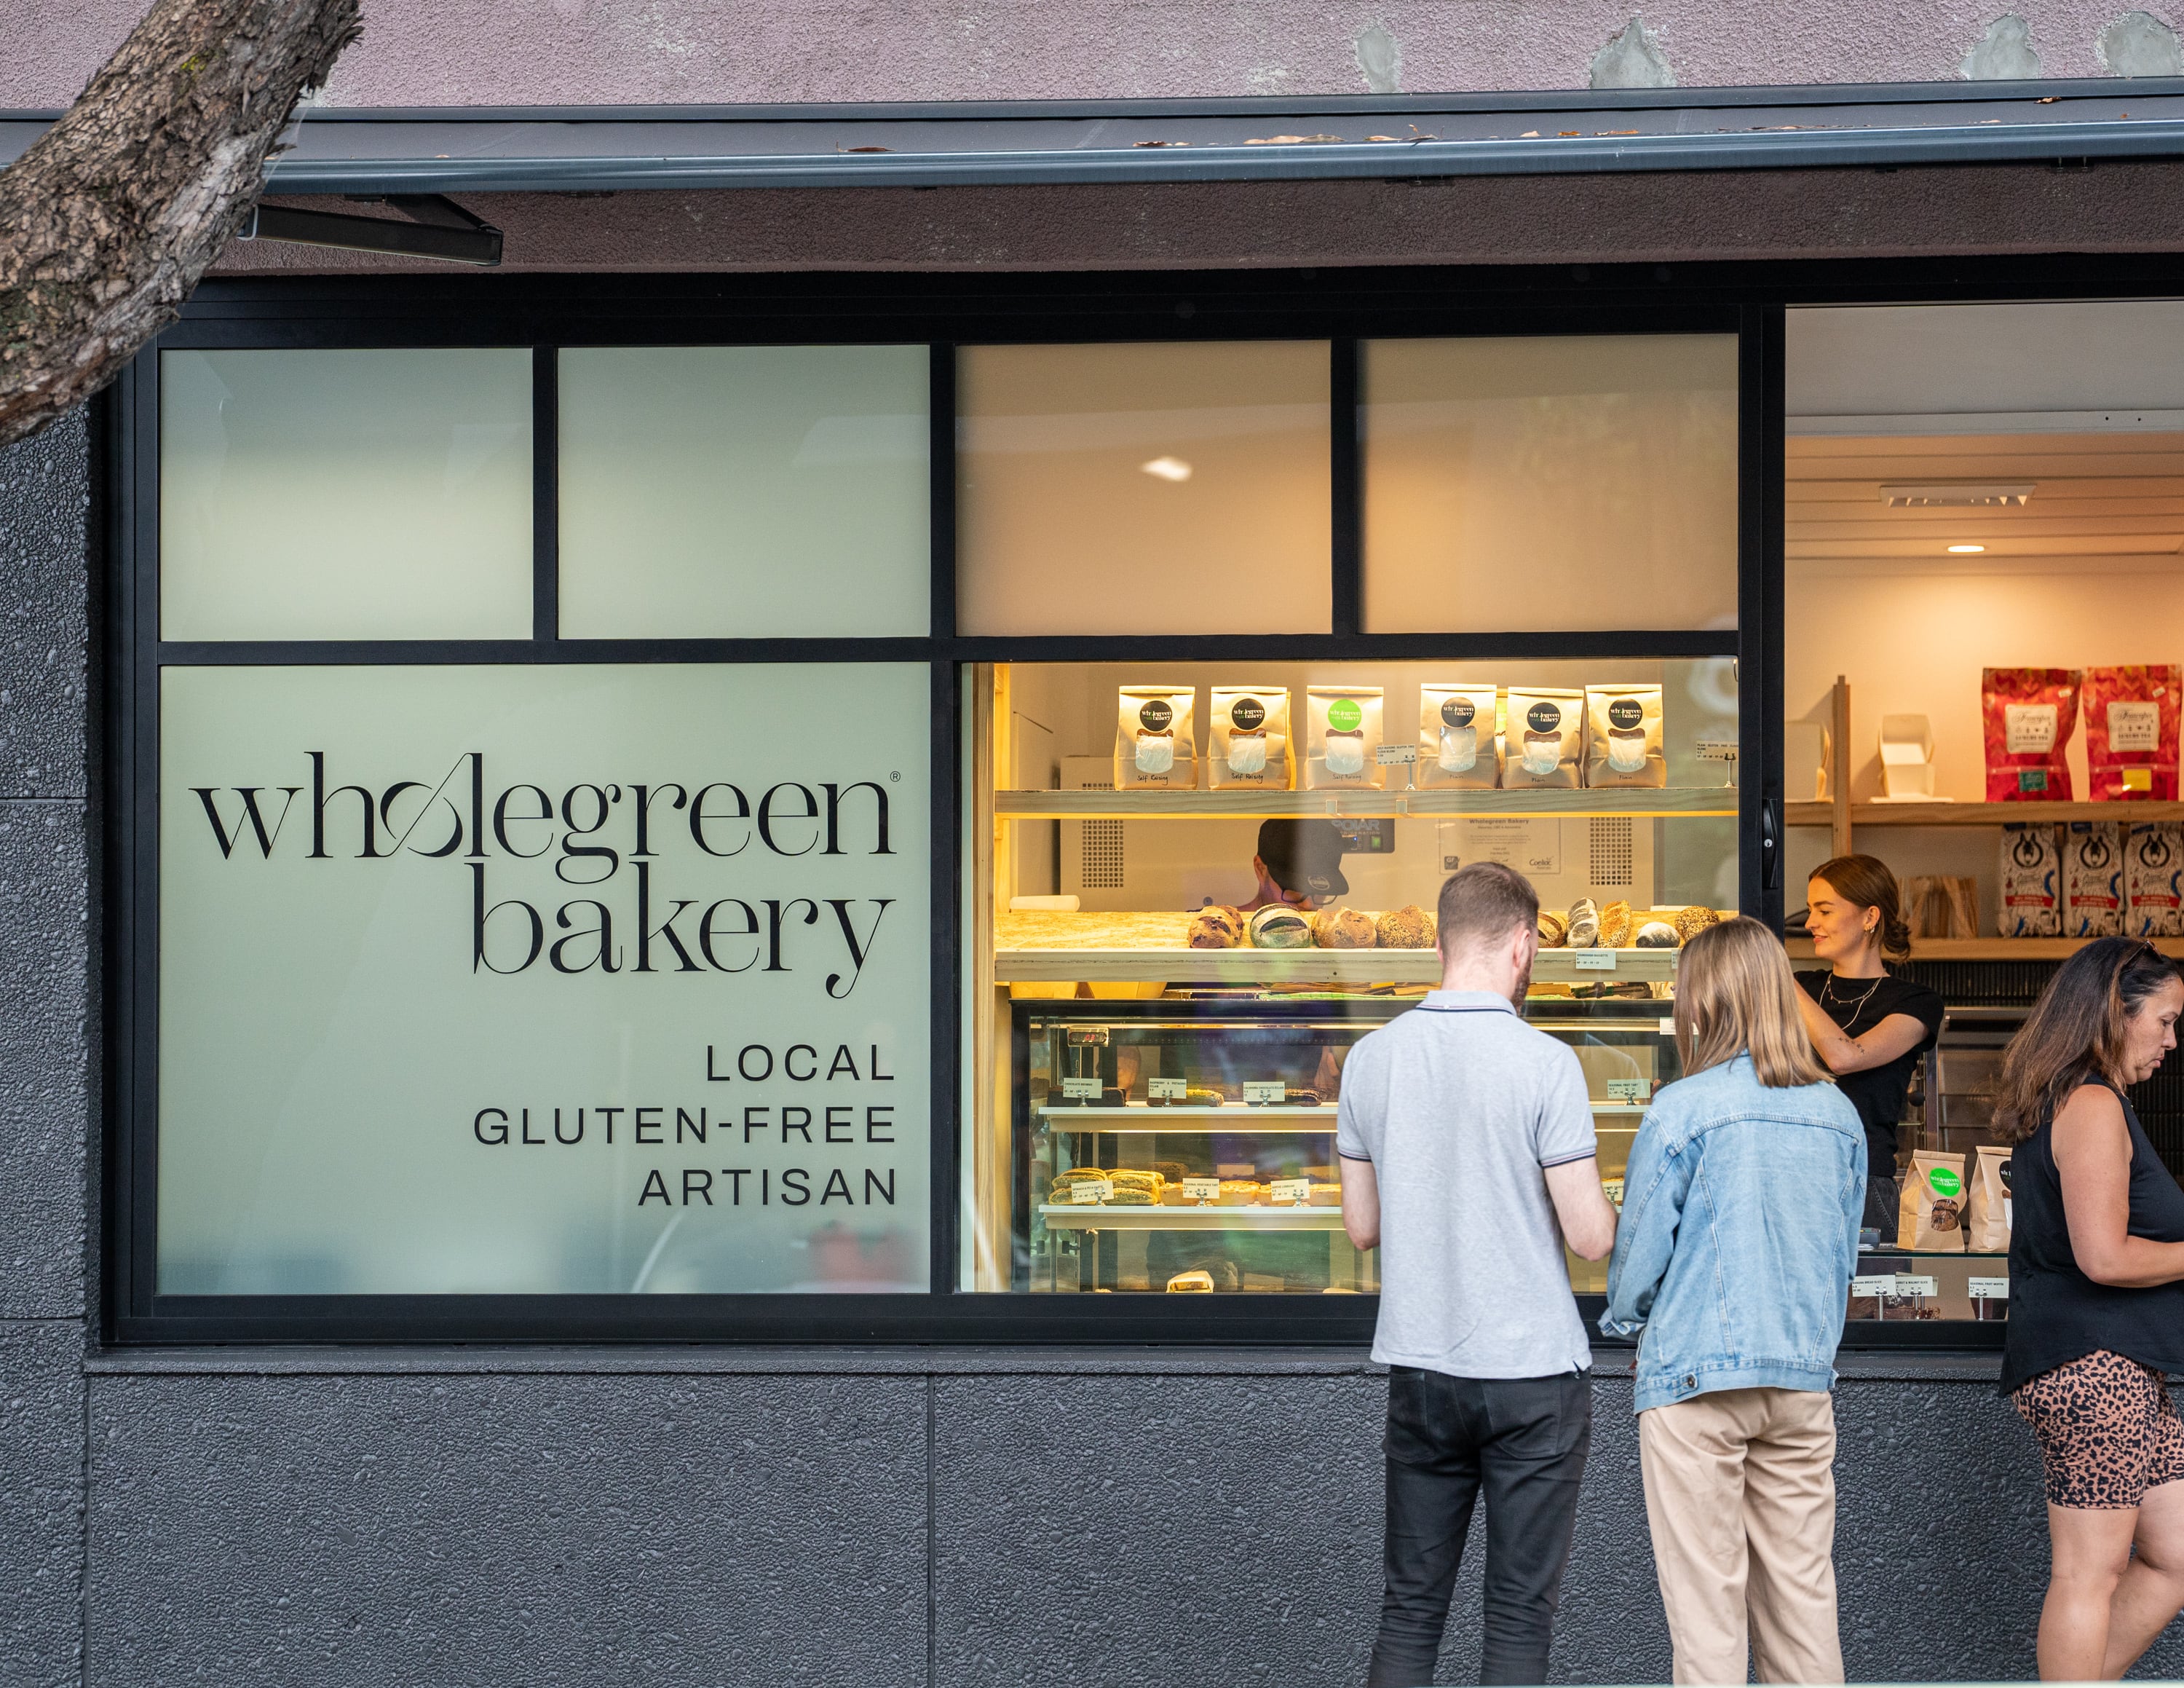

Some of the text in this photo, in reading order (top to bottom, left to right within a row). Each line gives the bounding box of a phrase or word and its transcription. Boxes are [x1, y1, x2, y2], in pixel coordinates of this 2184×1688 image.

[1137, 774, 1168, 786] Self Raising
[1231, 773, 1264, 784] Self Raising
[1530, 858, 1551, 866] Coeliac
[465, 861, 897, 998] bakery
[708, 1044, 894, 1081] LOCAL
[475, 1107, 894, 1145] GLUTEN-FREE
[638, 1169, 894, 1206] ARTISAN
